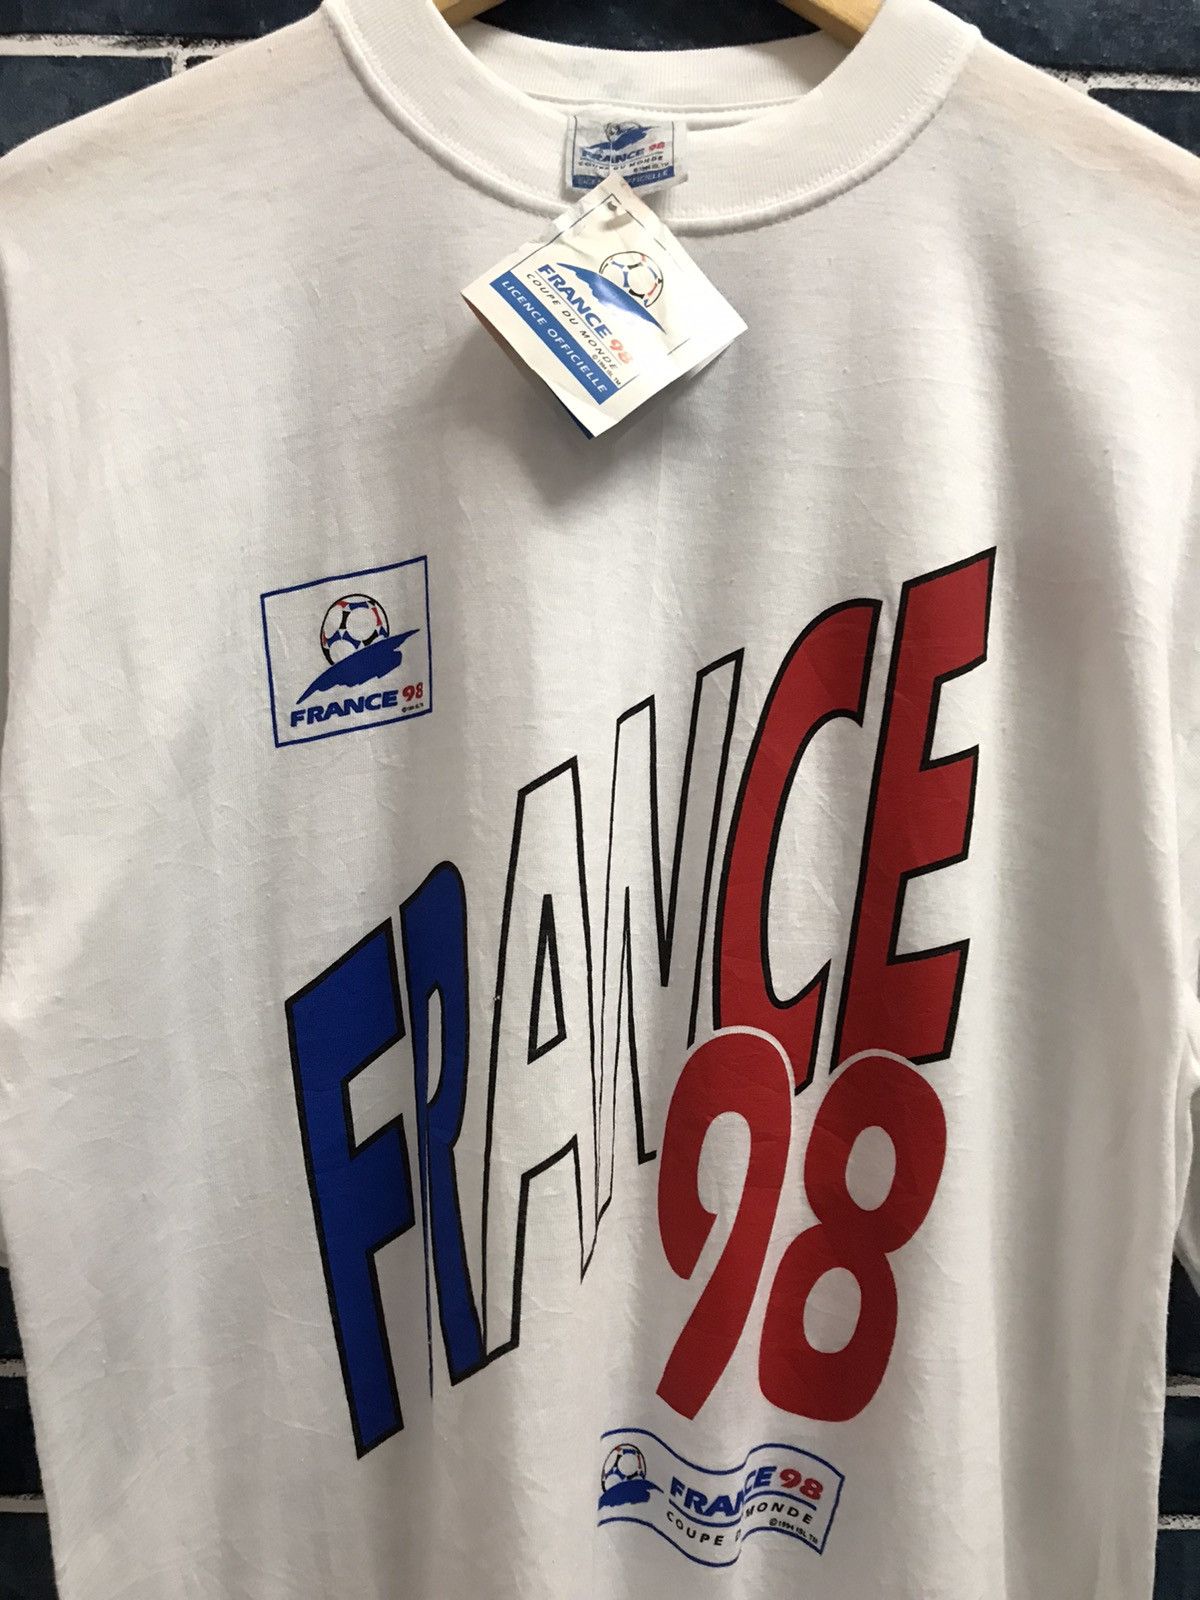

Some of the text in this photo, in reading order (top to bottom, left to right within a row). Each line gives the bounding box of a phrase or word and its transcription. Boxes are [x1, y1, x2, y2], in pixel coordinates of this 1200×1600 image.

[501, 280, 608, 393] LICENCE OFFICIELLE
[526, 273, 619, 369] COUPE DU MONDE
[537, 264, 612, 339] FRANCE
[290, 682, 424, 727] FRANCE 98
[286, 546, 996, 1460] FRANCE
[656, 1030, 948, 1422] 98
[666, 1510, 724, 1546] COUPE
[745, 1502, 813, 1525] MONDE
[779, 1468, 824, 1500] 98
